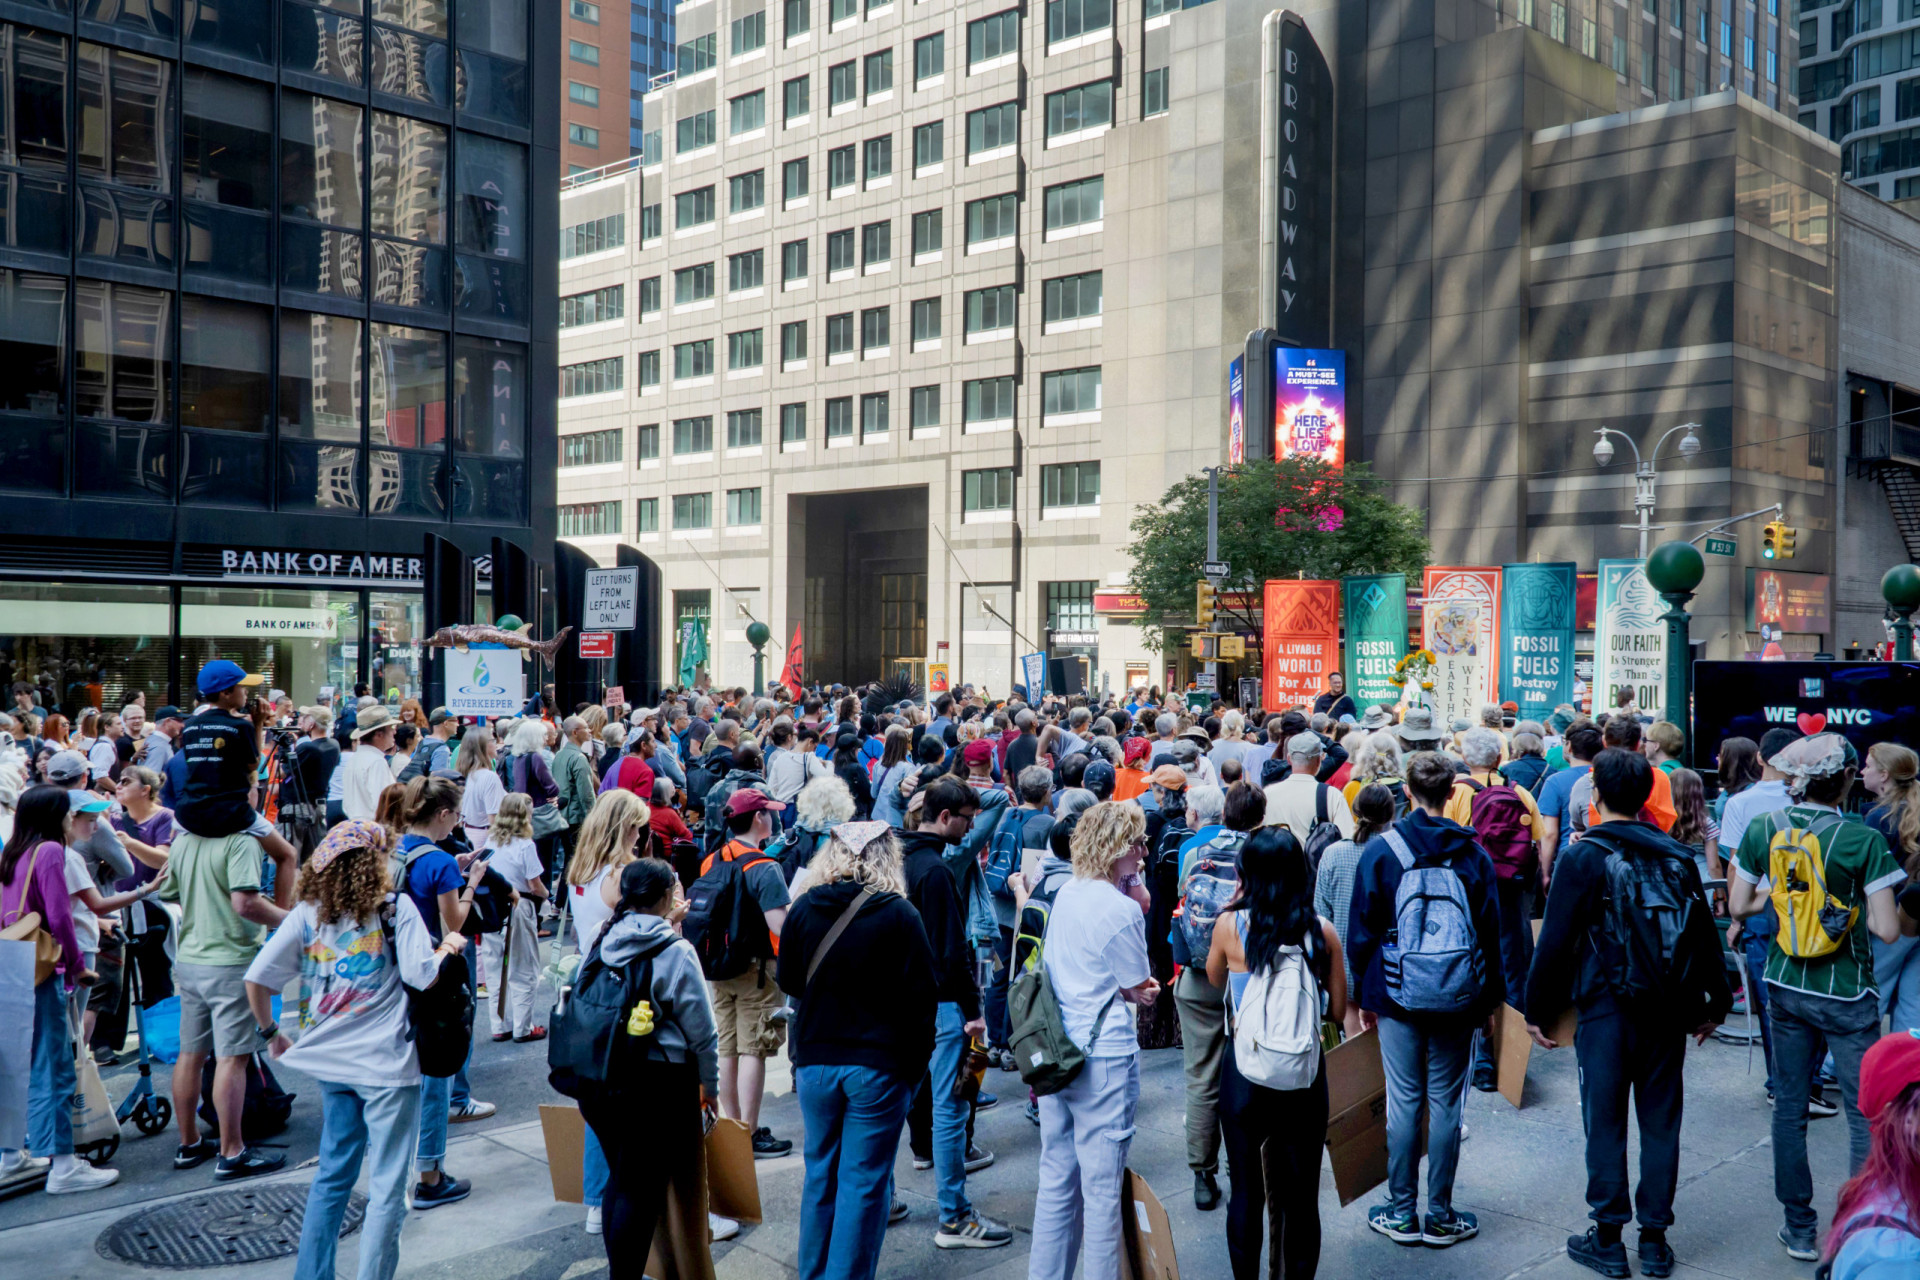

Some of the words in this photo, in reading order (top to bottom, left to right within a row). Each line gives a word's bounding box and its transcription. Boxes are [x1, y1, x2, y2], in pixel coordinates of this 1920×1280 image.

[1281, 48, 1297, 313] BROADWAY
[1294, 415, 1327, 427] HERE
[1297, 427, 1325, 439] LIES
[1294, 439, 1327, 451] LOVE
[1711, 542, 1717, 551] W
[222, 550, 300, 570] BANK
[308, 553, 343, 572] OF
[591, 576, 608, 586] LEFT
[610, 575, 632, 585] TURNS
[600, 588, 622, 597] FROM
[589, 601, 608, 611] LEFT
[610, 600, 631, 610] LANE
[600, 613, 619, 623] ONLY
[246, 619, 277, 629] BANK
[279, 621, 291, 629] OF
[293, 621, 324, 630] AMERIC
[1356, 641, 1396, 656] FOSSIL
[1513, 636, 1560, 652] FOSSIL
[1611, 634, 1631, 651] OUR
[1633, 634, 1661, 652] FAITH
[1278, 644, 1284, 654] A
[1287, 644, 1322, 655] LIVABLE
[1278, 658, 1322, 673] WORLD
[1356, 658, 1397, 675] FUELS
[1513, 656, 1559, 675] FUELS
[1610, 655, 1619, 665] Is
[1621, 655, 1661, 667] Stronger
[1624, 669, 1648, 680] Than
[1278, 676, 1299, 688] For
[1303, 676, 1321, 689] All
[1357, 678, 1395, 687] Desecra
[1512, 677, 1559, 690] Destroy
[1278, 692, 1318, 707] Being
[1358, 688, 1399, 699] Creation
[1525, 690, 1548, 702] Life
[1638, 684, 1661, 710] OIL
[452, 698, 514, 709] RIVERKEEPER
[1764, 706, 1797, 723] WE
[1826, 707, 1872, 725] NYC
